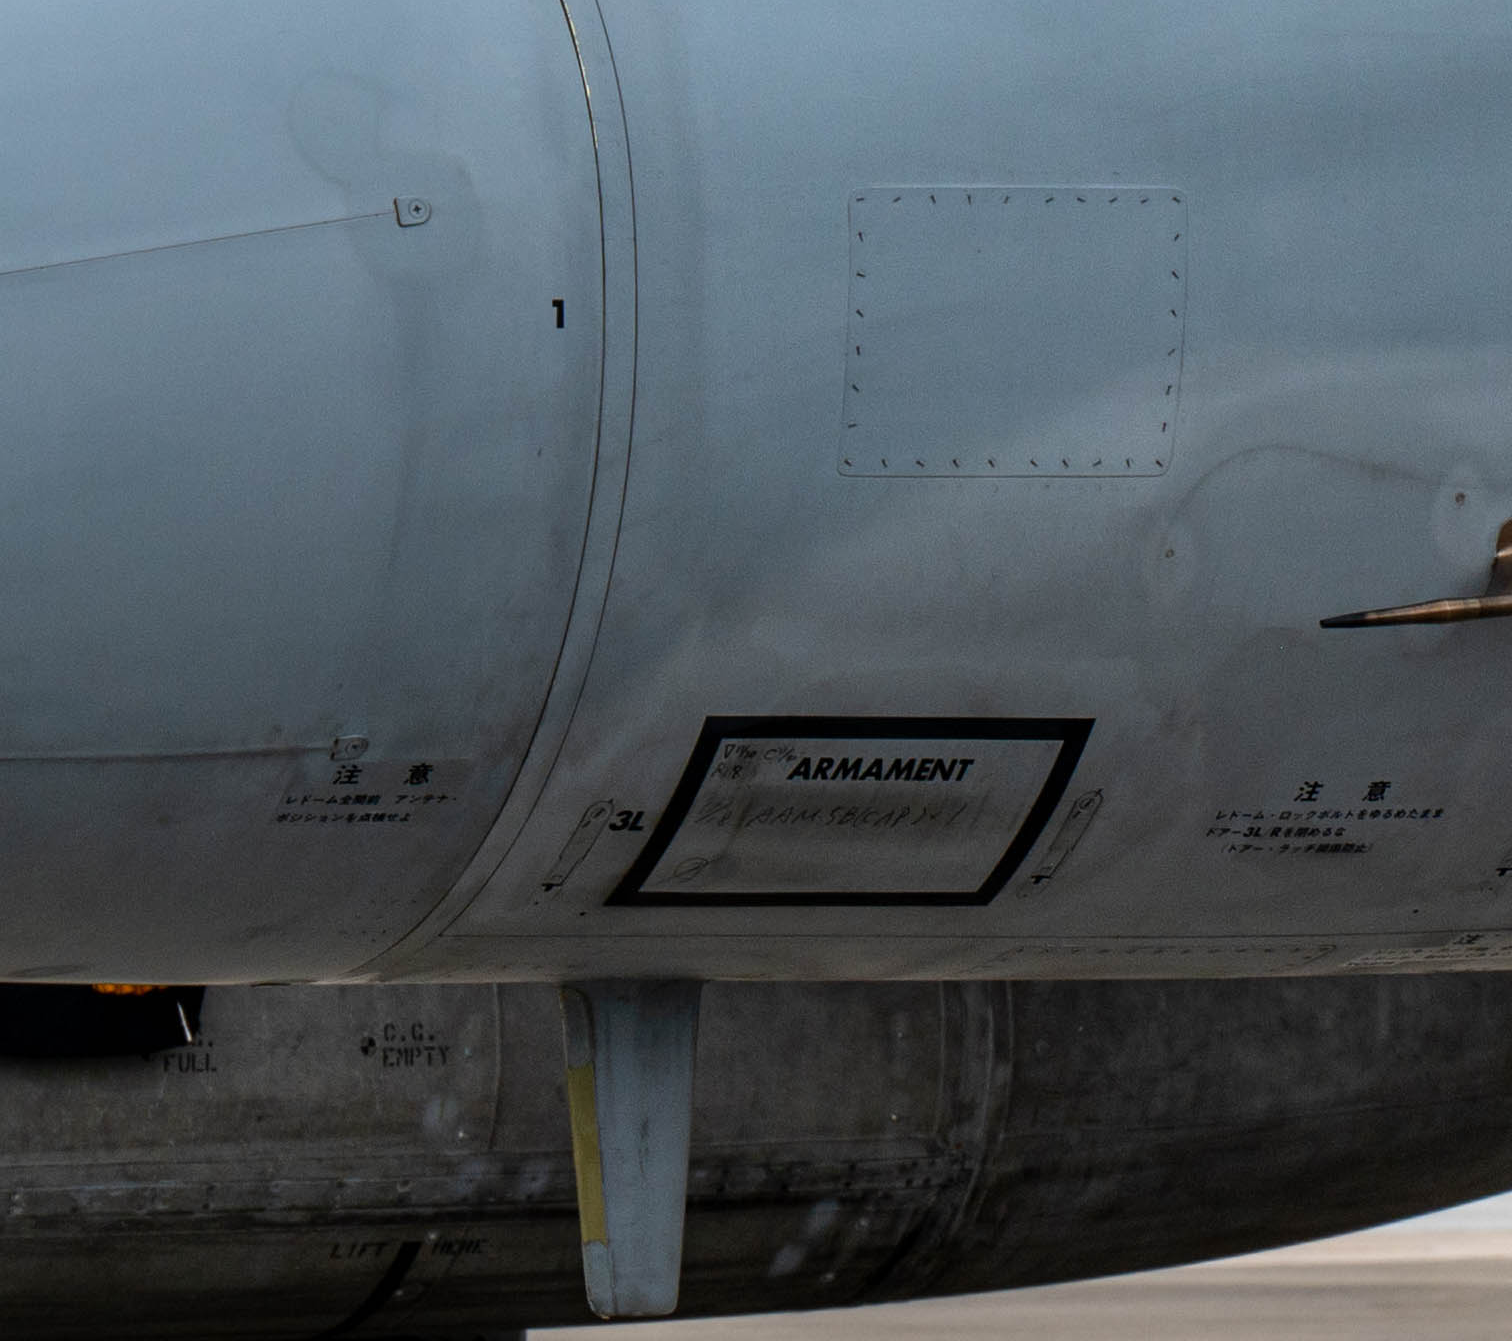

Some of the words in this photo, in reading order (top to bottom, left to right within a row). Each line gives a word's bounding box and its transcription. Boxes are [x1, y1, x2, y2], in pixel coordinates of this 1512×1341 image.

[552, 299, 565, 328] 1
[333, 763, 433, 785] 注意
[787, 757, 974, 781] ARMAMENT
[1294, 781, 1391, 802] 注意
[610, 810, 644, 831] 3L
[163, 1053, 217, 1074] FULL
[383, 1045, 451, 1068] EMPTY
